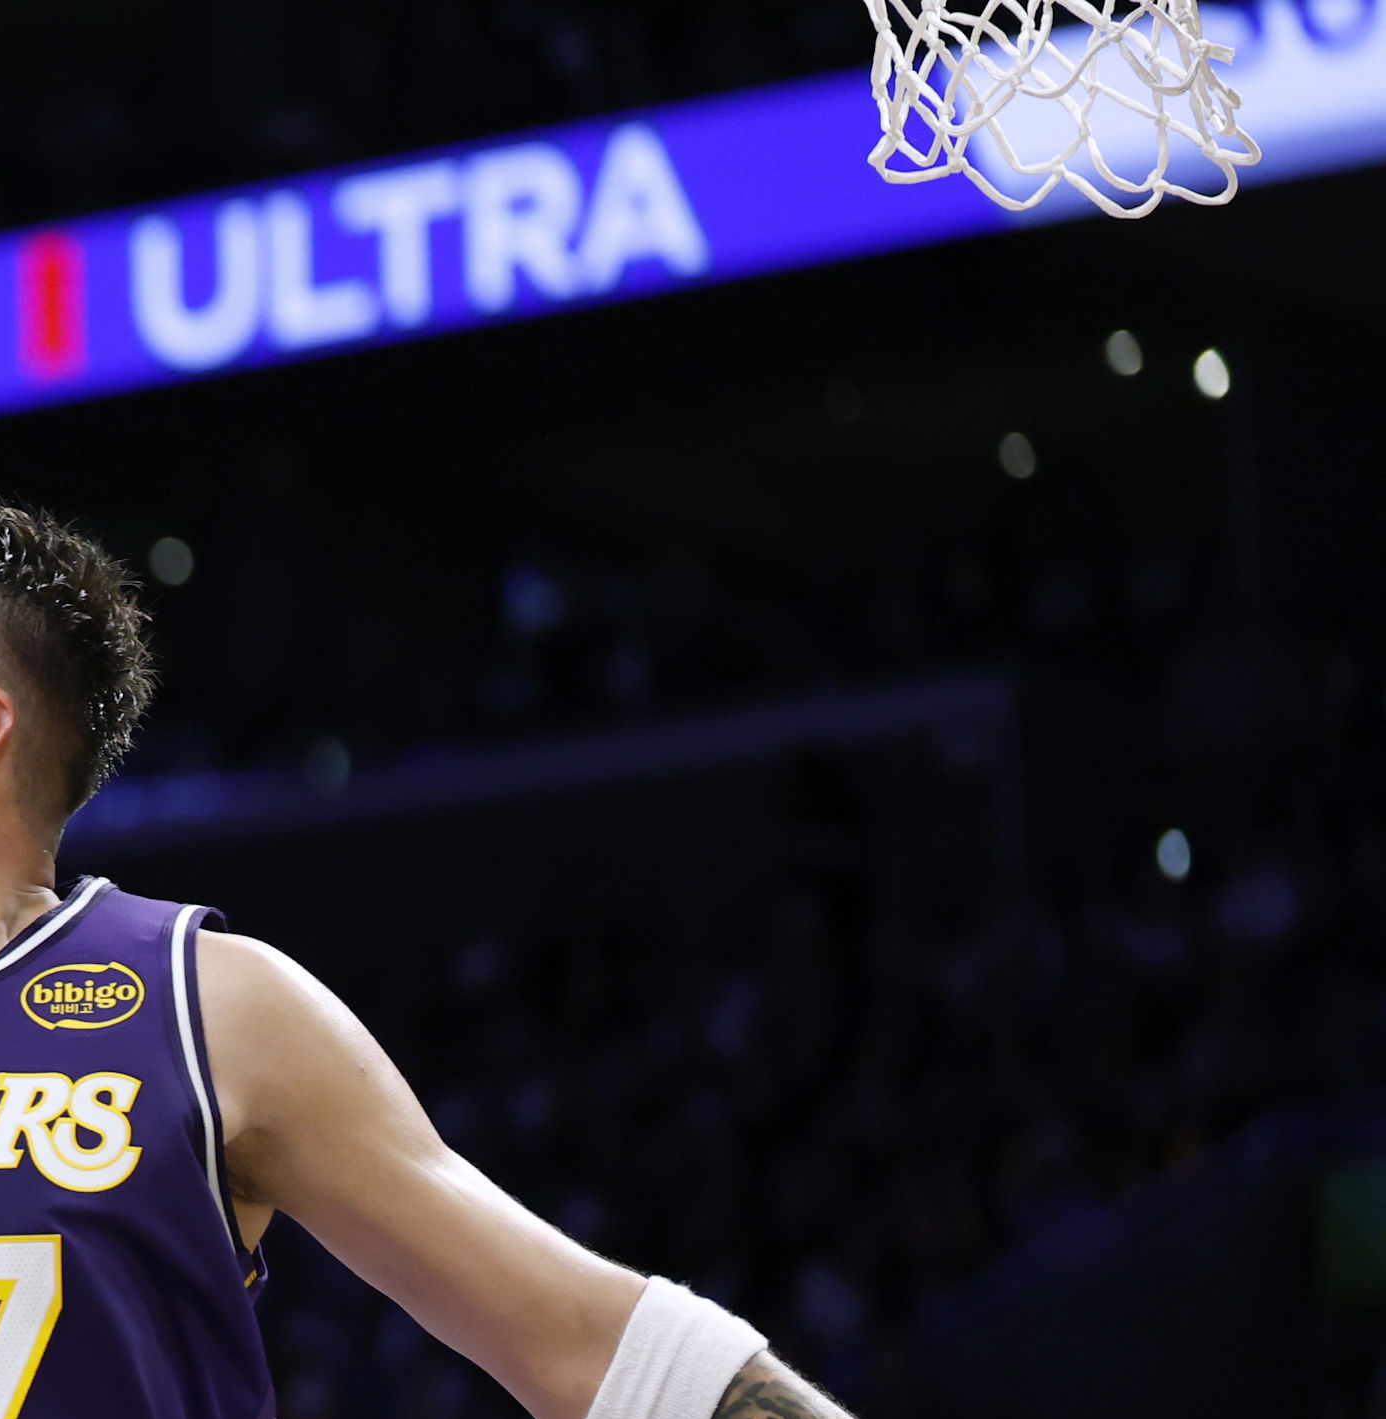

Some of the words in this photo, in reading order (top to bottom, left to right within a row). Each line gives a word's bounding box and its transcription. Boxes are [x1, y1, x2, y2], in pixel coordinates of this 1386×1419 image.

[131, 121, 711, 370] ULTRA
[33, 979, 137, 1009] bibigo
[50, 1002, 95, 1015] 비비고
